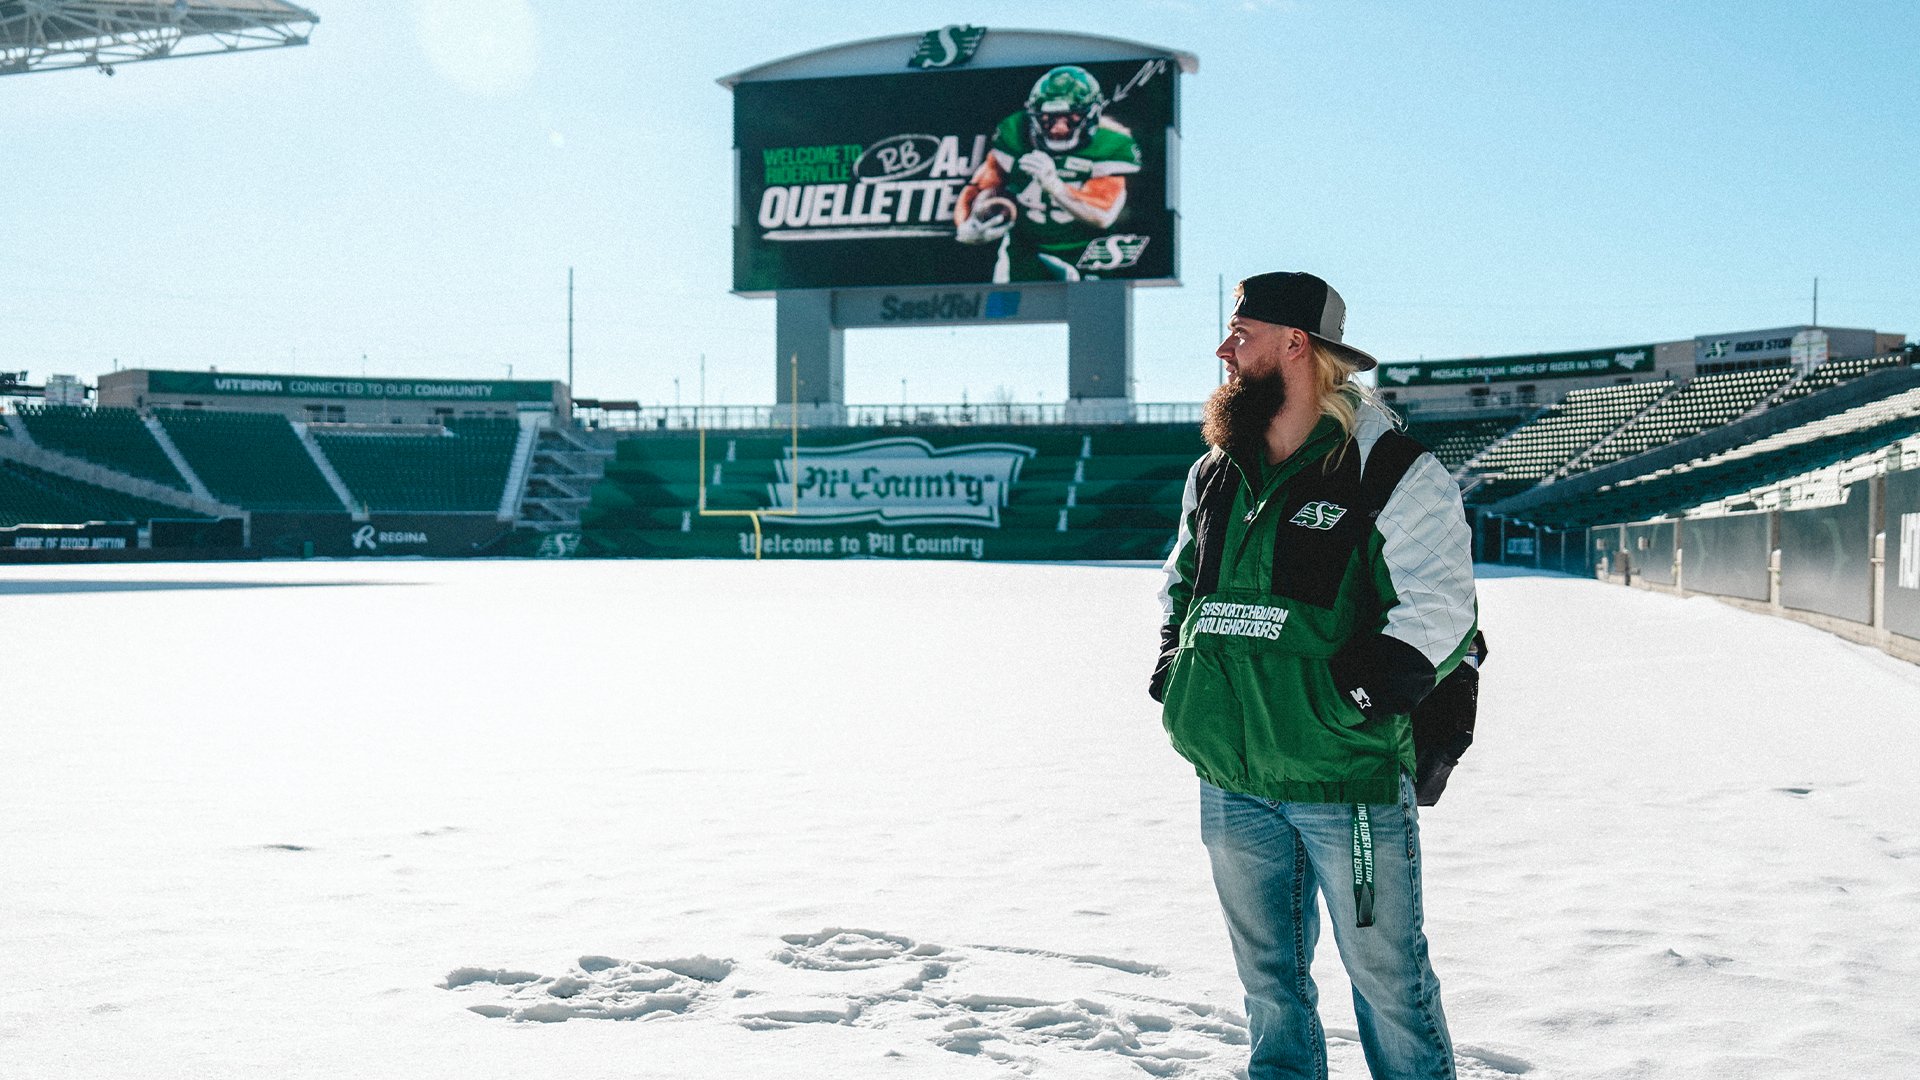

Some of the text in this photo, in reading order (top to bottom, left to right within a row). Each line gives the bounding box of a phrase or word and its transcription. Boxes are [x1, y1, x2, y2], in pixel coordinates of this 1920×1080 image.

[763, 144, 863, 165] WELCOME TO
[876, 140, 921, 173] RB
[929, 134, 986, 178] AJ
[765, 163, 850, 185] RIDERVILLE
[758, 178, 966, 229] OUELLETTE
[1735, 339, 1764, 352] RIDER
[1431, 359, 1609, 379] MOSAIC STADIUM HOME OF RIDER NATION
[214, 378, 283, 392] VITERRA
[289, 380, 493, 398] CONNECTED TO OUR COMMUNITY
[797, 466, 986, 506] Pil Country
[45, 537, 58, 549] OF
[379, 531, 428, 544] REGINA
[738, 532, 984, 558] Welcome to Pil Country
[1200, 601, 1289, 624] SASKATCHEWAN
[1196, 616, 1283, 641] ROUGHRIDERS
[1359, 822, 1372, 849] RIDER
[1353, 858, 1363, 885] RIDER
[1363, 849, 1373, 883] NATION
